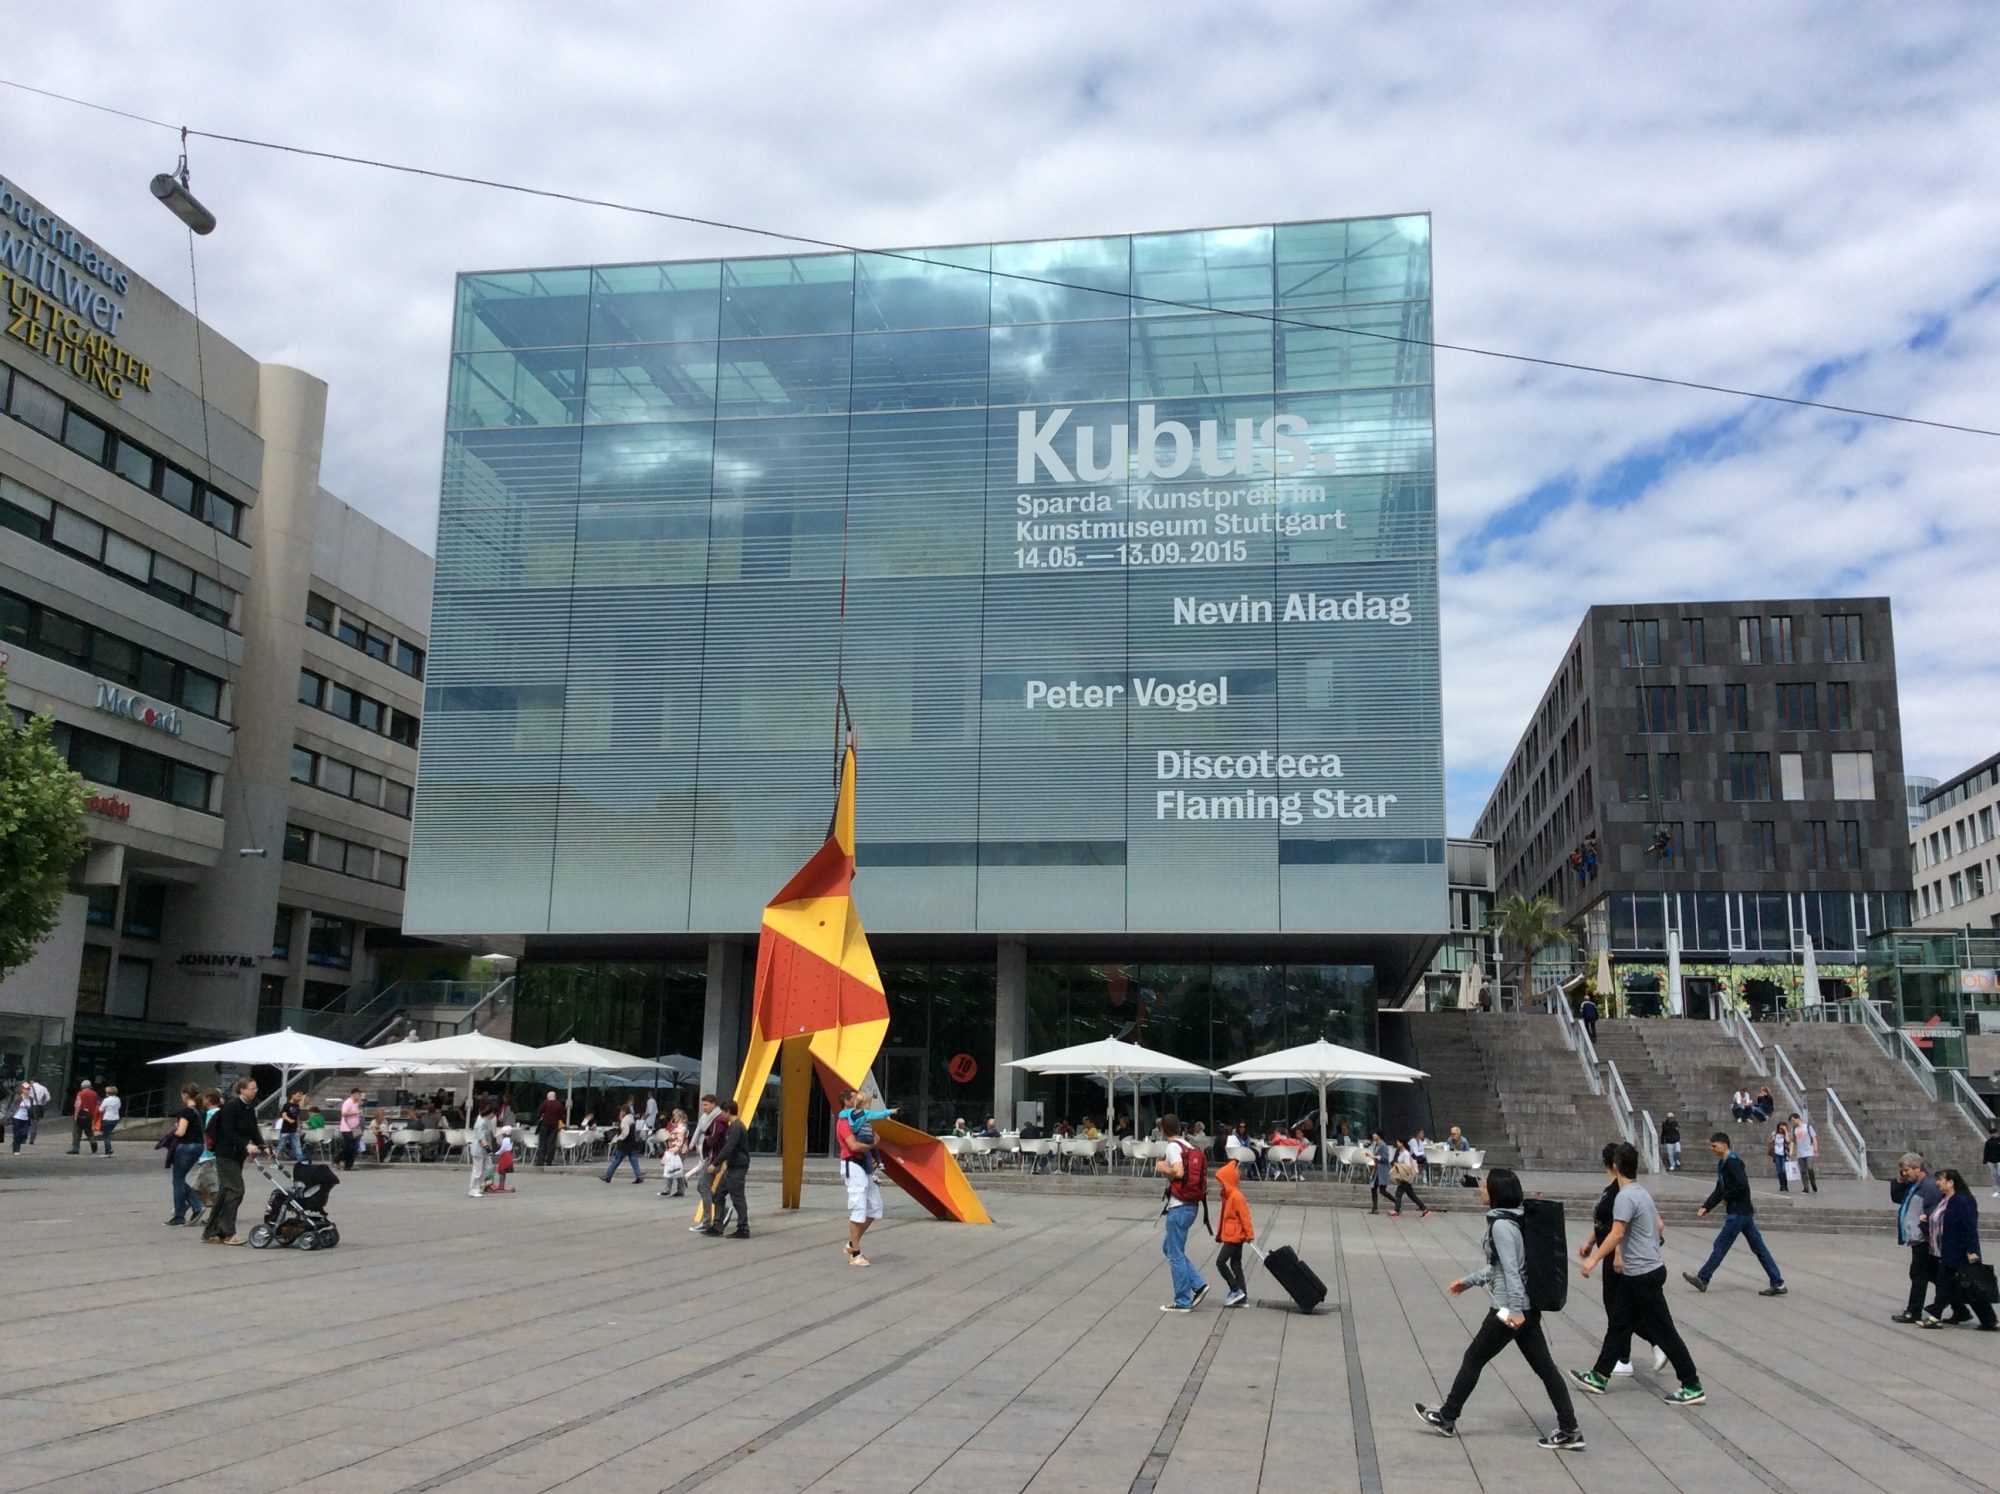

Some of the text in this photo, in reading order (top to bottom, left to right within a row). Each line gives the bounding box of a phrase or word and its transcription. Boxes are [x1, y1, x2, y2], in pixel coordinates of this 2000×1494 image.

[0, 180, 129, 295] buchhaus
[0, 226, 123, 337] wittwer
[0, 271, 152, 392] UTTGARTER
[6, 308, 124, 400] ZEITUNG
[1017, 404, 1336, 484] Kubus.
[1016, 491, 1113, 518] Sparda
[1137, 482, 1285, 511] Kunstpreis
[1293, 482, 1326, 503] im
[1016, 508, 1347, 541] Kunstmuseum Stuttgart
[1173, 592, 1412, 626] Nevin Aladag
[1026, 676, 1228, 712] Peter Vogel
[1156, 749, 1344, 779] Discoteca
[1156, 788, 1398, 826] Flaming Star
